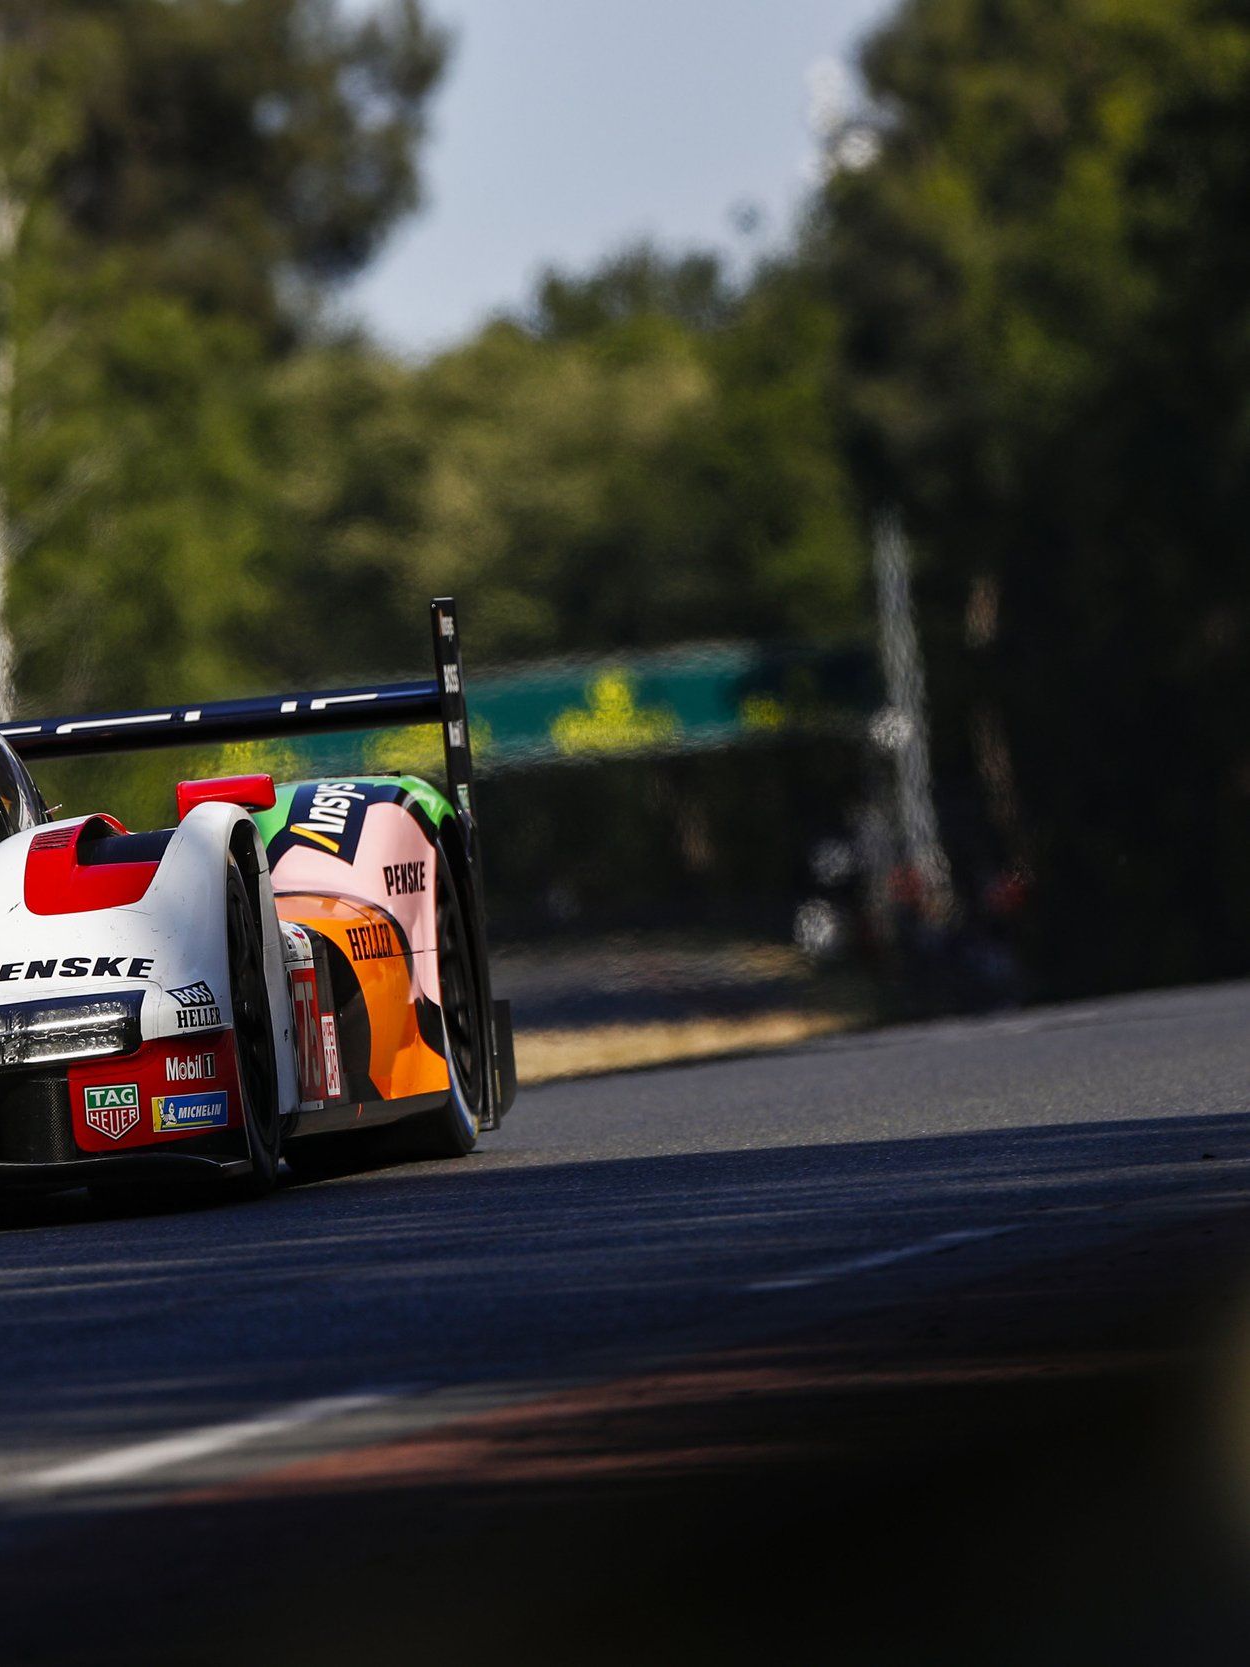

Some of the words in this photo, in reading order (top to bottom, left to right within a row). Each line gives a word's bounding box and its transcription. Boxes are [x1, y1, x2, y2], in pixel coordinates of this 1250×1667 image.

[289, 783, 366, 854] Ansys
[383, 861, 426, 897] PENSKE
[346, 923, 393, 961] HELLER
[172, 984, 212, 1004] BOSS
[176, 1007, 221, 1028] HELLER
[166, 1054, 203, 1081] Mobil
[90, 1089, 133, 1106] TAG
[89, 1109, 137, 1135] HEUER
[178, 1104, 222, 1119] MICHELIN
